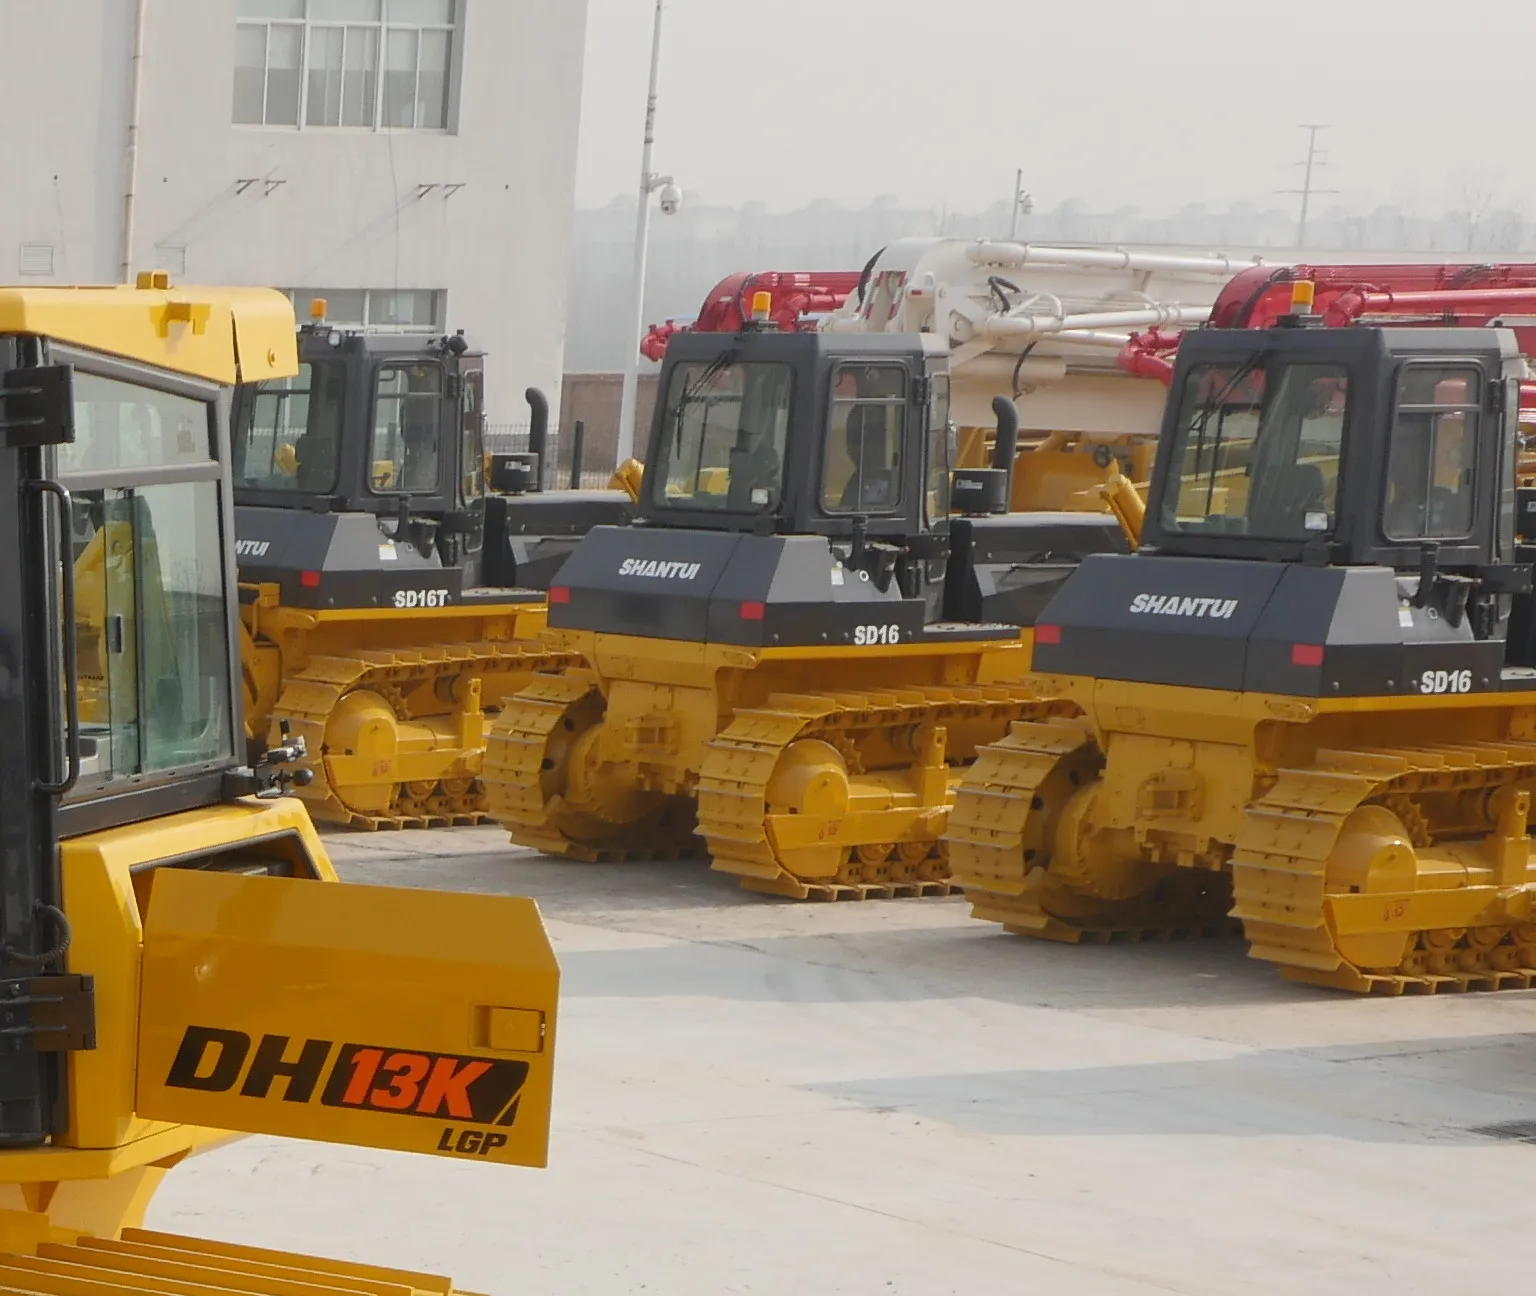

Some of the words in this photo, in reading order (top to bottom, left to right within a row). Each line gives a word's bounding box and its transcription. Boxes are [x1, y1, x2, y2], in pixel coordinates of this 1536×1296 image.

[234, 539, 270, 557] NTUI
[618, 558, 702, 580] SHANTUI
[394, 589, 449, 608] SD16T
[1129, 593, 1238, 619] SHANTUI
[854, 624, 899, 645] SD16
[1420, 669, 1473, 693] SD16
[165, 1025, 494, 1119] DH13K
[437, 1128, 508, 1156] LGP
